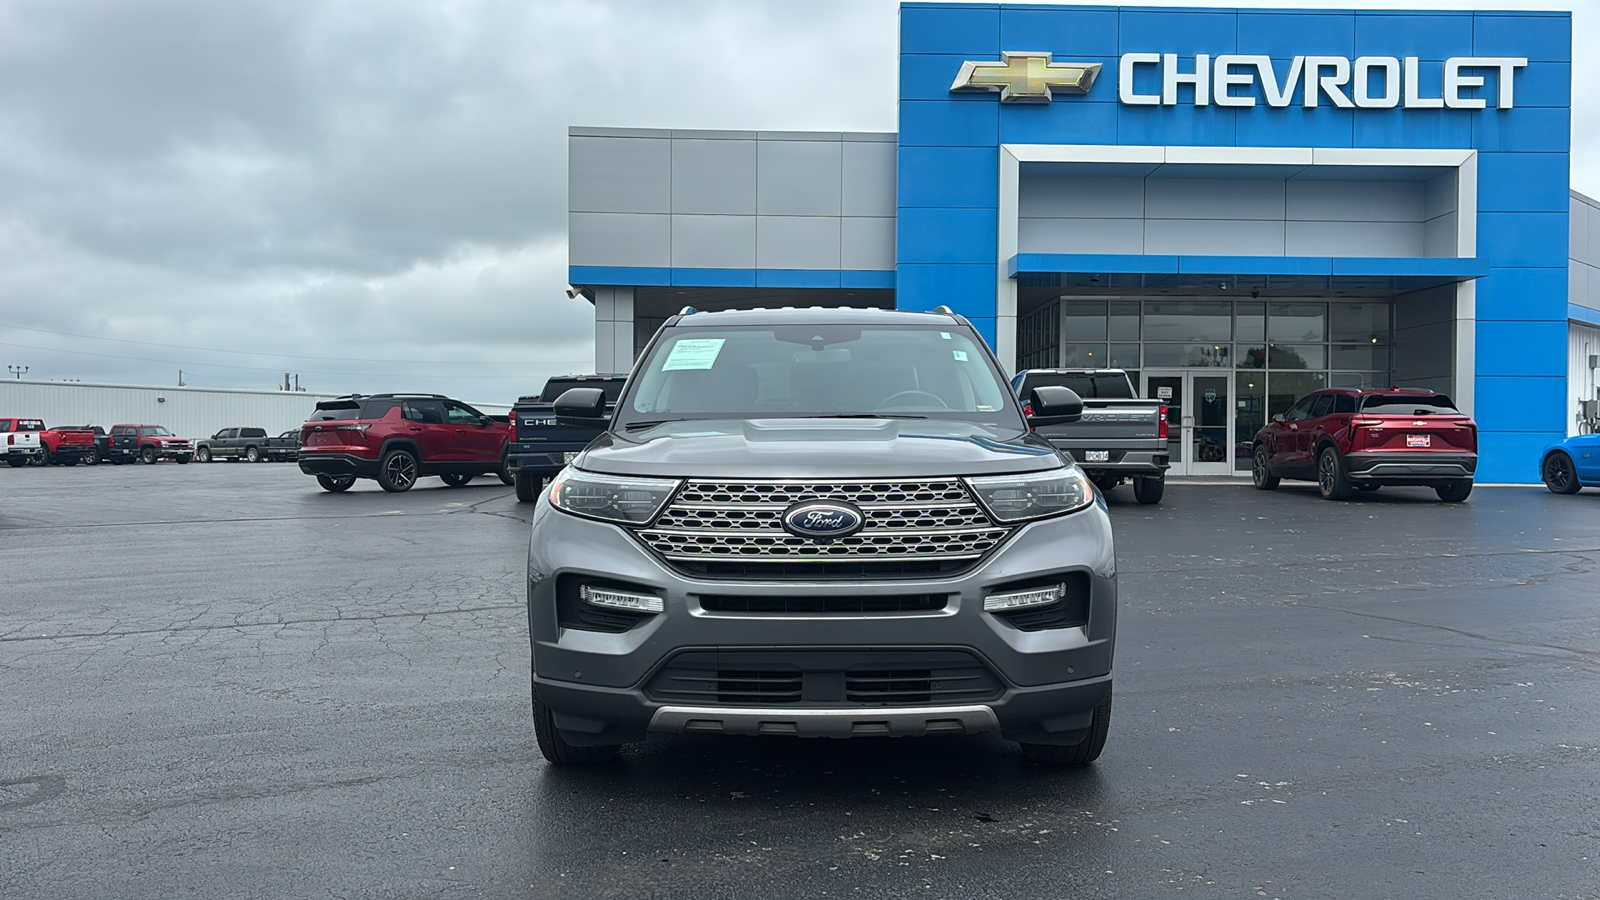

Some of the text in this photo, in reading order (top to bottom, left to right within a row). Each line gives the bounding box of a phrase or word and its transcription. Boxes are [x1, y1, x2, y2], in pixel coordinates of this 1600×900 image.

[1118, 52, 1528, 111] CHEVROLET
[1081, 414, 1152, 422] VROLET
[803, 510, 844, 528] Ford
